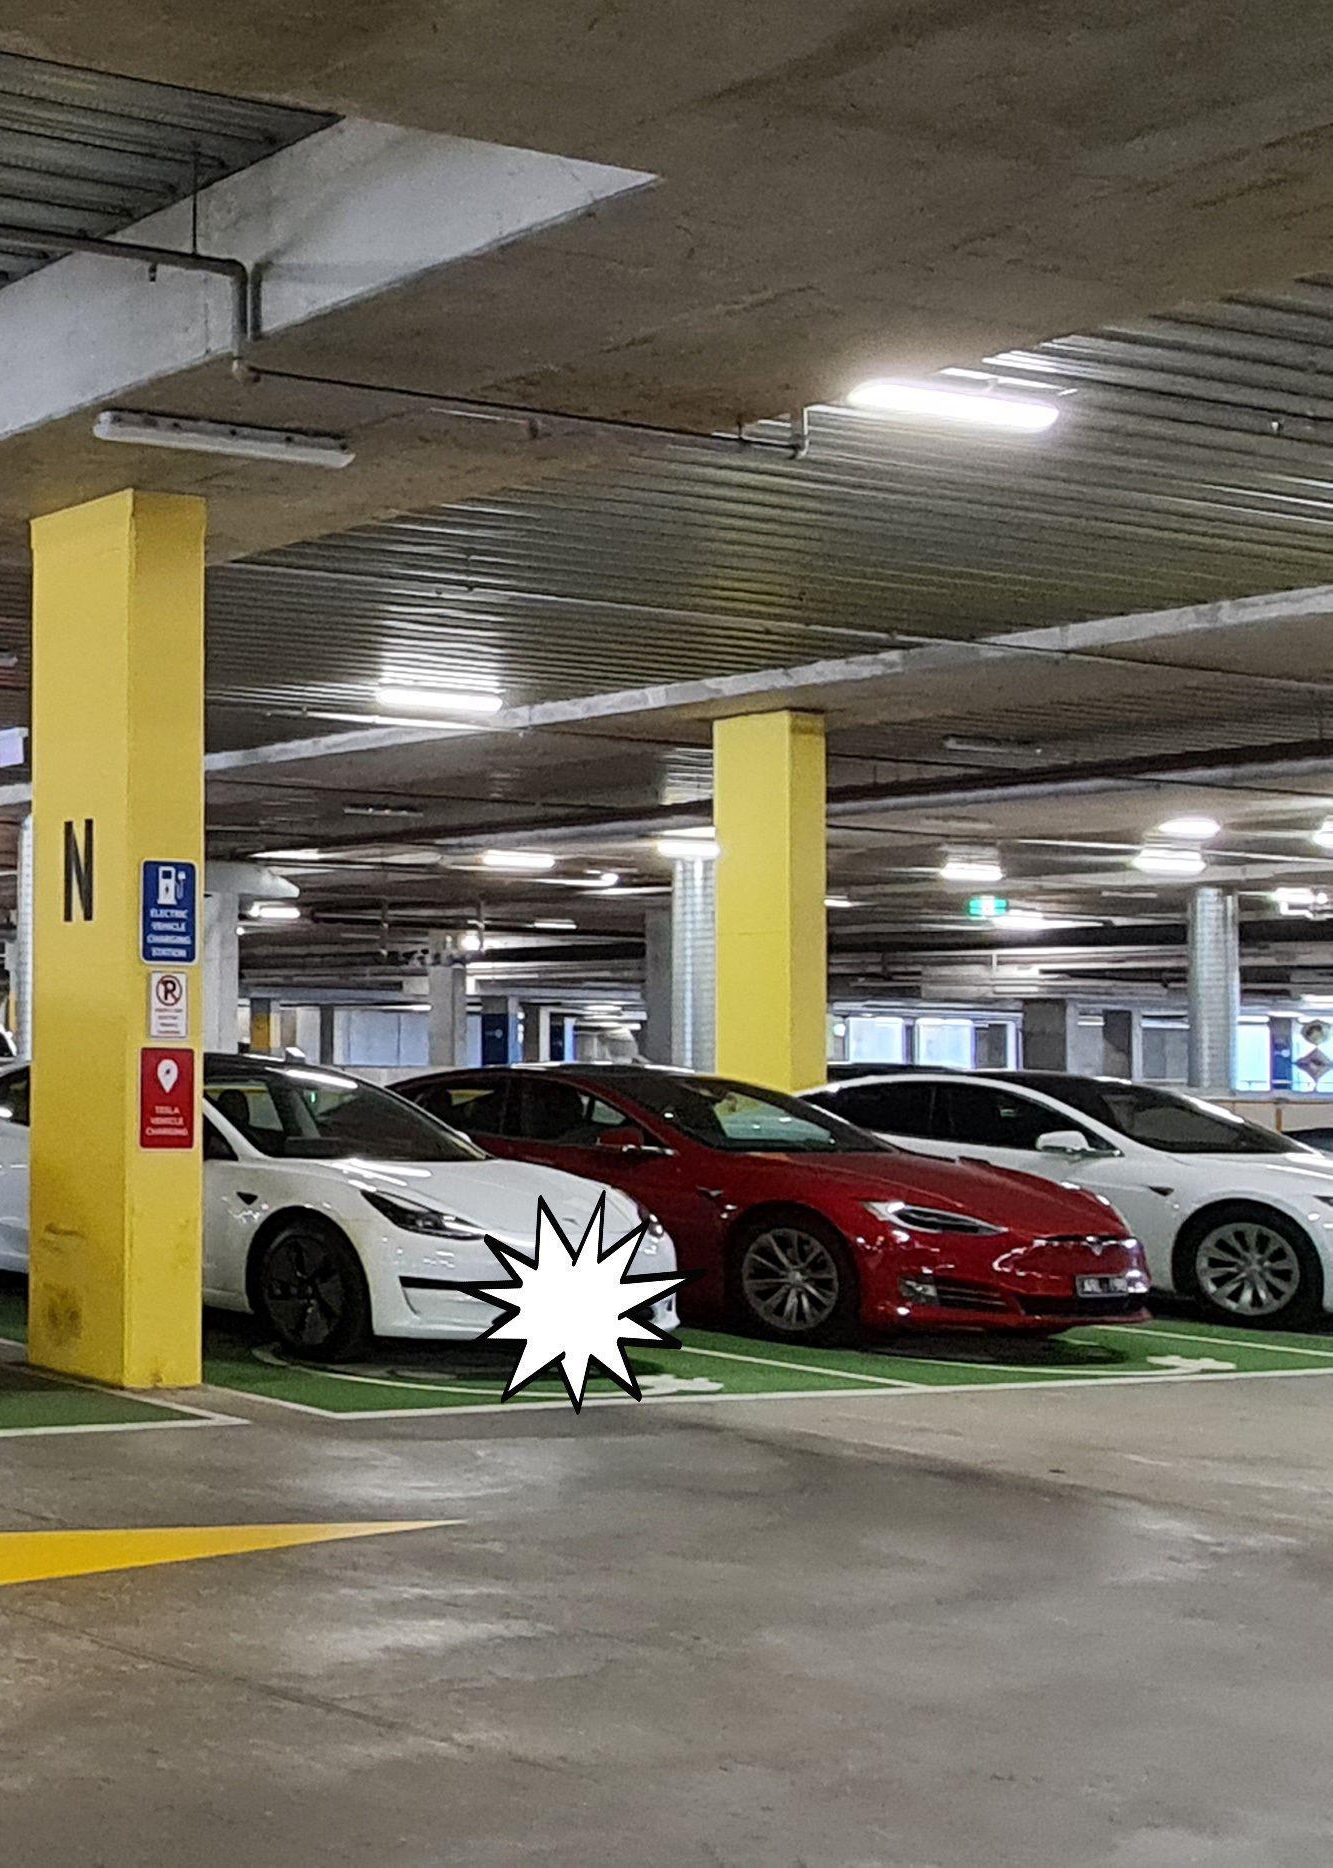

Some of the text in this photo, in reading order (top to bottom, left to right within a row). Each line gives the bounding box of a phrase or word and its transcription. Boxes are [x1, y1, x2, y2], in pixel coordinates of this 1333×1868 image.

[64, 818, 93, 922] N
[149, 907, 188, 919] ELECTRIC
[150, 921, 186, 932] VEHICLE
[146, 933, 192, 945] CHARGING
[151, 946, 187, 957] STATION
[155, 1105, 181, 1115] TESLA
[150, 1116, 184, 1126] VEHICLE
[145, 1126, 189, 1136] CHARGING
